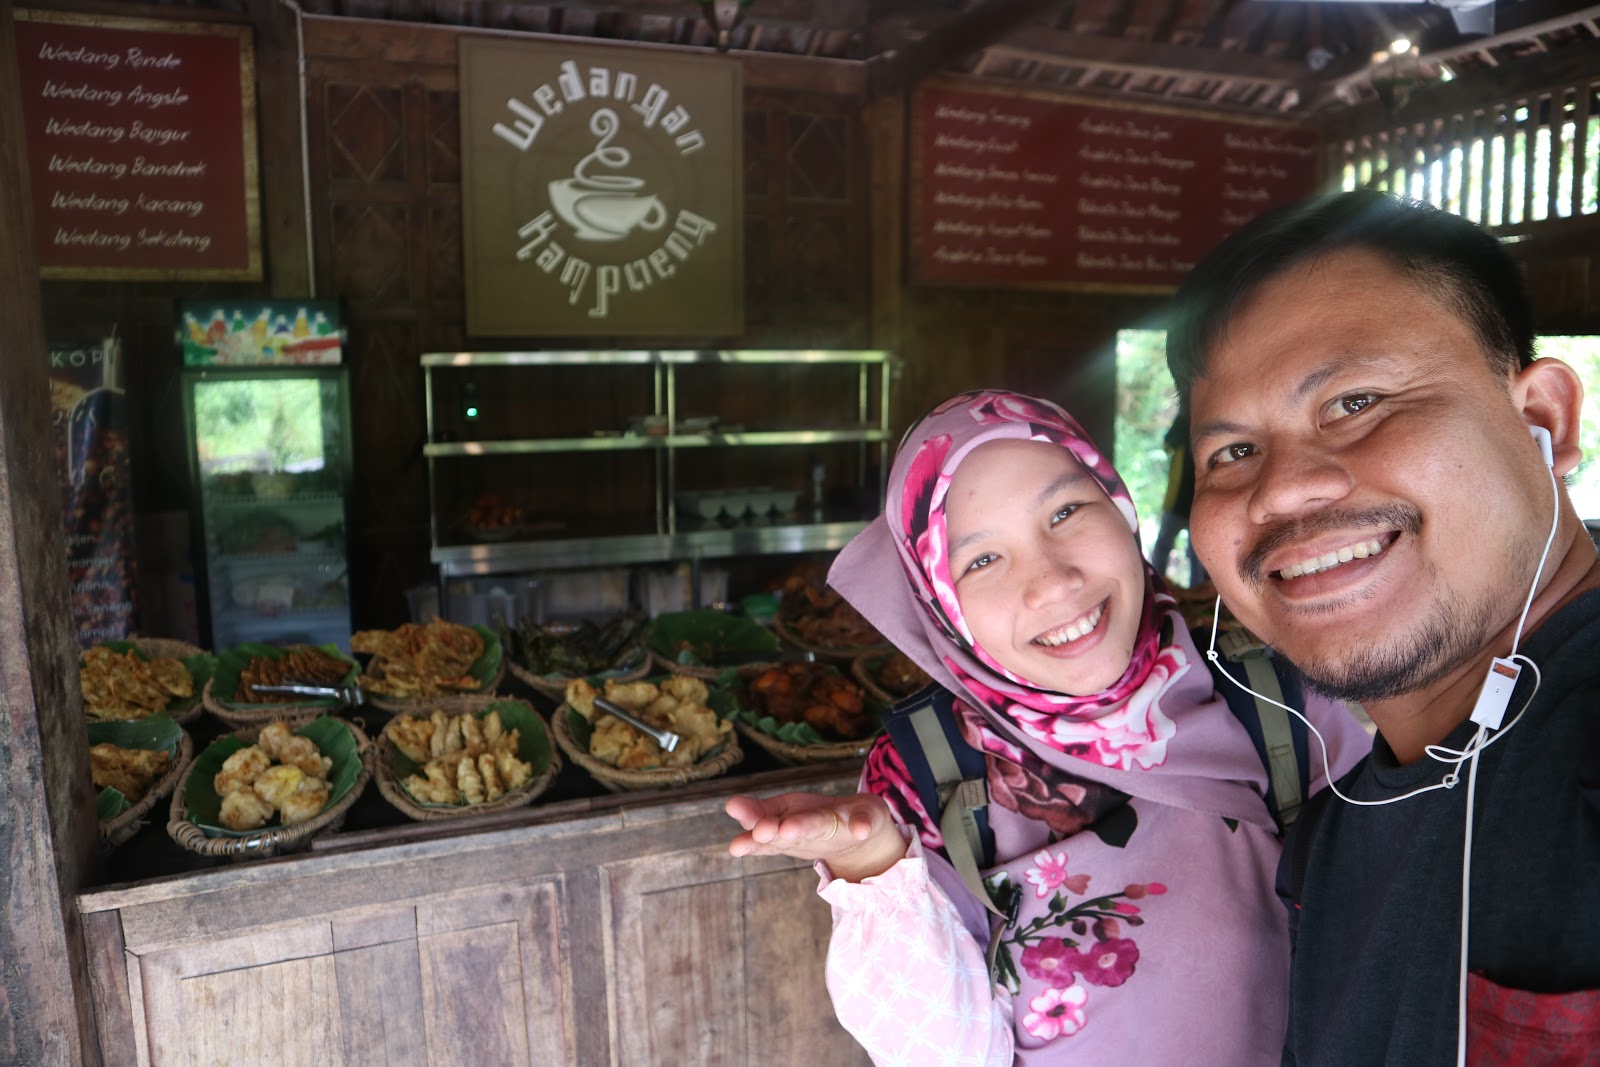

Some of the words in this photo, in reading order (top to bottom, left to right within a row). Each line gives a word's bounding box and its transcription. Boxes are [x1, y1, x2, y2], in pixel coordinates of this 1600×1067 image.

[39, 42, 120, 70] Wedang
[124, 47, 182, 69] Ronde
[42, 80, 122, 106] Wedang
[126, 84, 189, 109] Angsle
[492, 59, 705, 155] Wedangan
[45, 117, 125, 143] Wedang
[129, 120, 191, 144] Bajigur
[48, 154, 127, 179] Wedang
[131, 156, 207, 177] Bandrek
[51, 190, 129, 215] Wedang
[136, 192, 204, 218] Kacang
[54, 227, 131, 251] Wedang
[515, 209, 717, 317] Kampoeng
